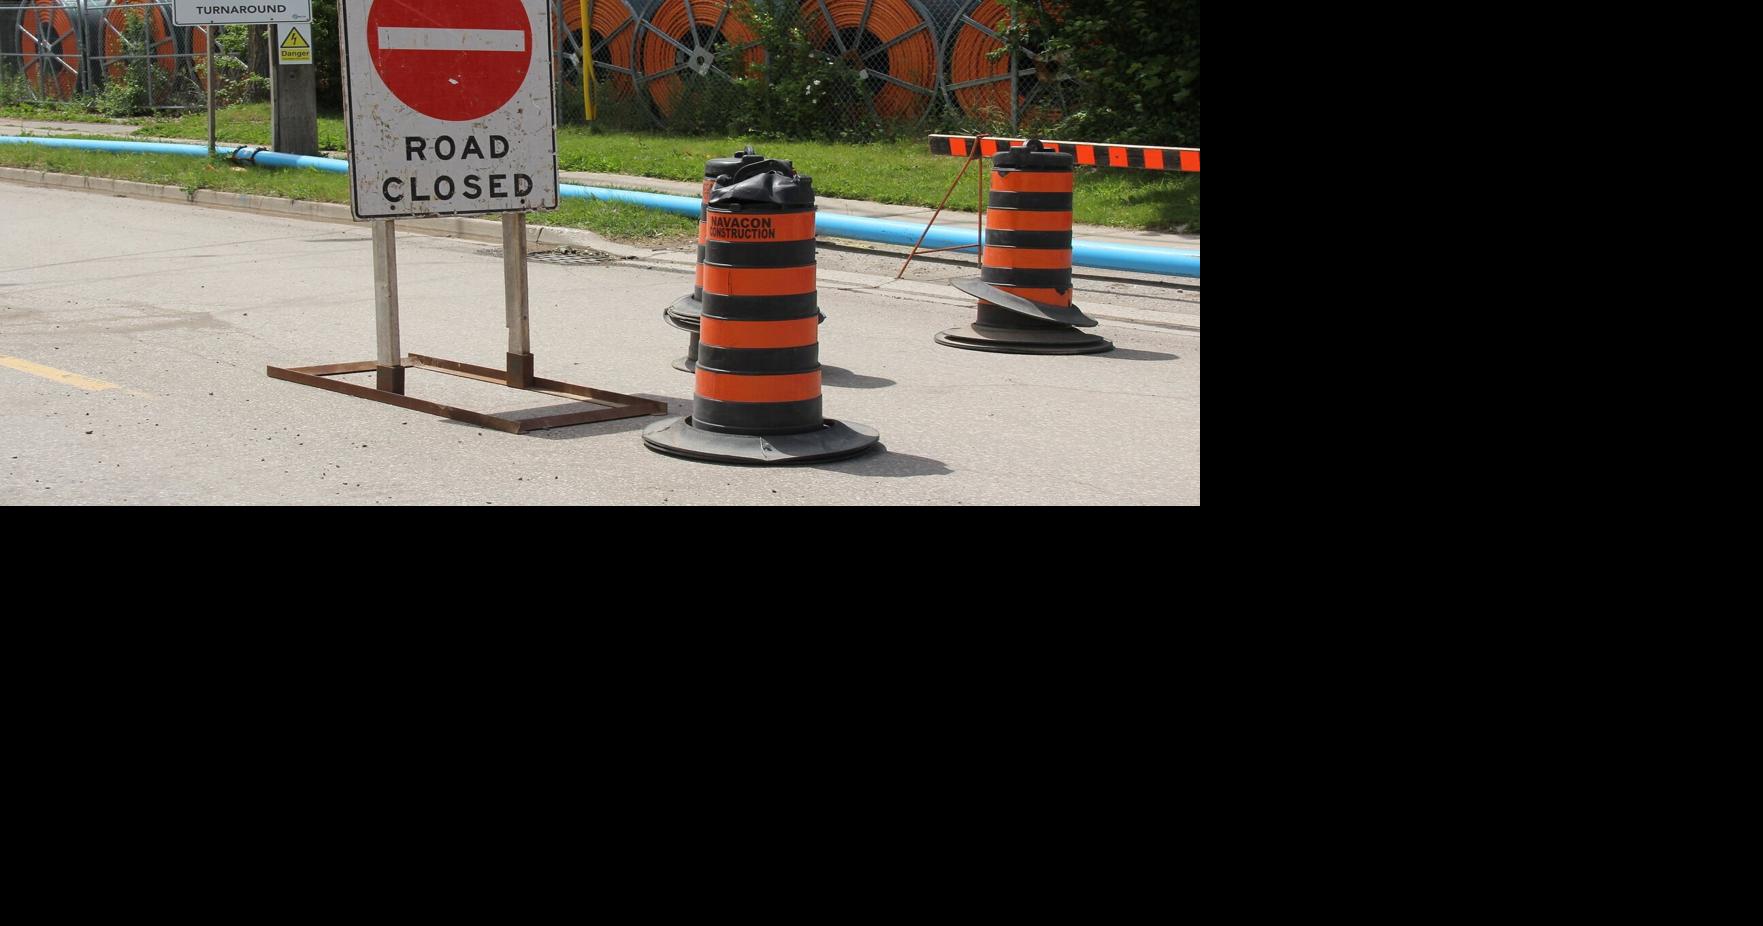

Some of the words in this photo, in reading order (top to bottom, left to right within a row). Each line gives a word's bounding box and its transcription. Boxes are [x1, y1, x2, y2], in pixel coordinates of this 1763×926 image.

[195, 4, 286, 15] TURNAROUND
[405, 135, 510, 161] ROAD
[382, 173, 534, 203] CLOSED
[711, 216, 772, 228] NAVACON
[710, 227, 775, 239] CONSTRUCTION
